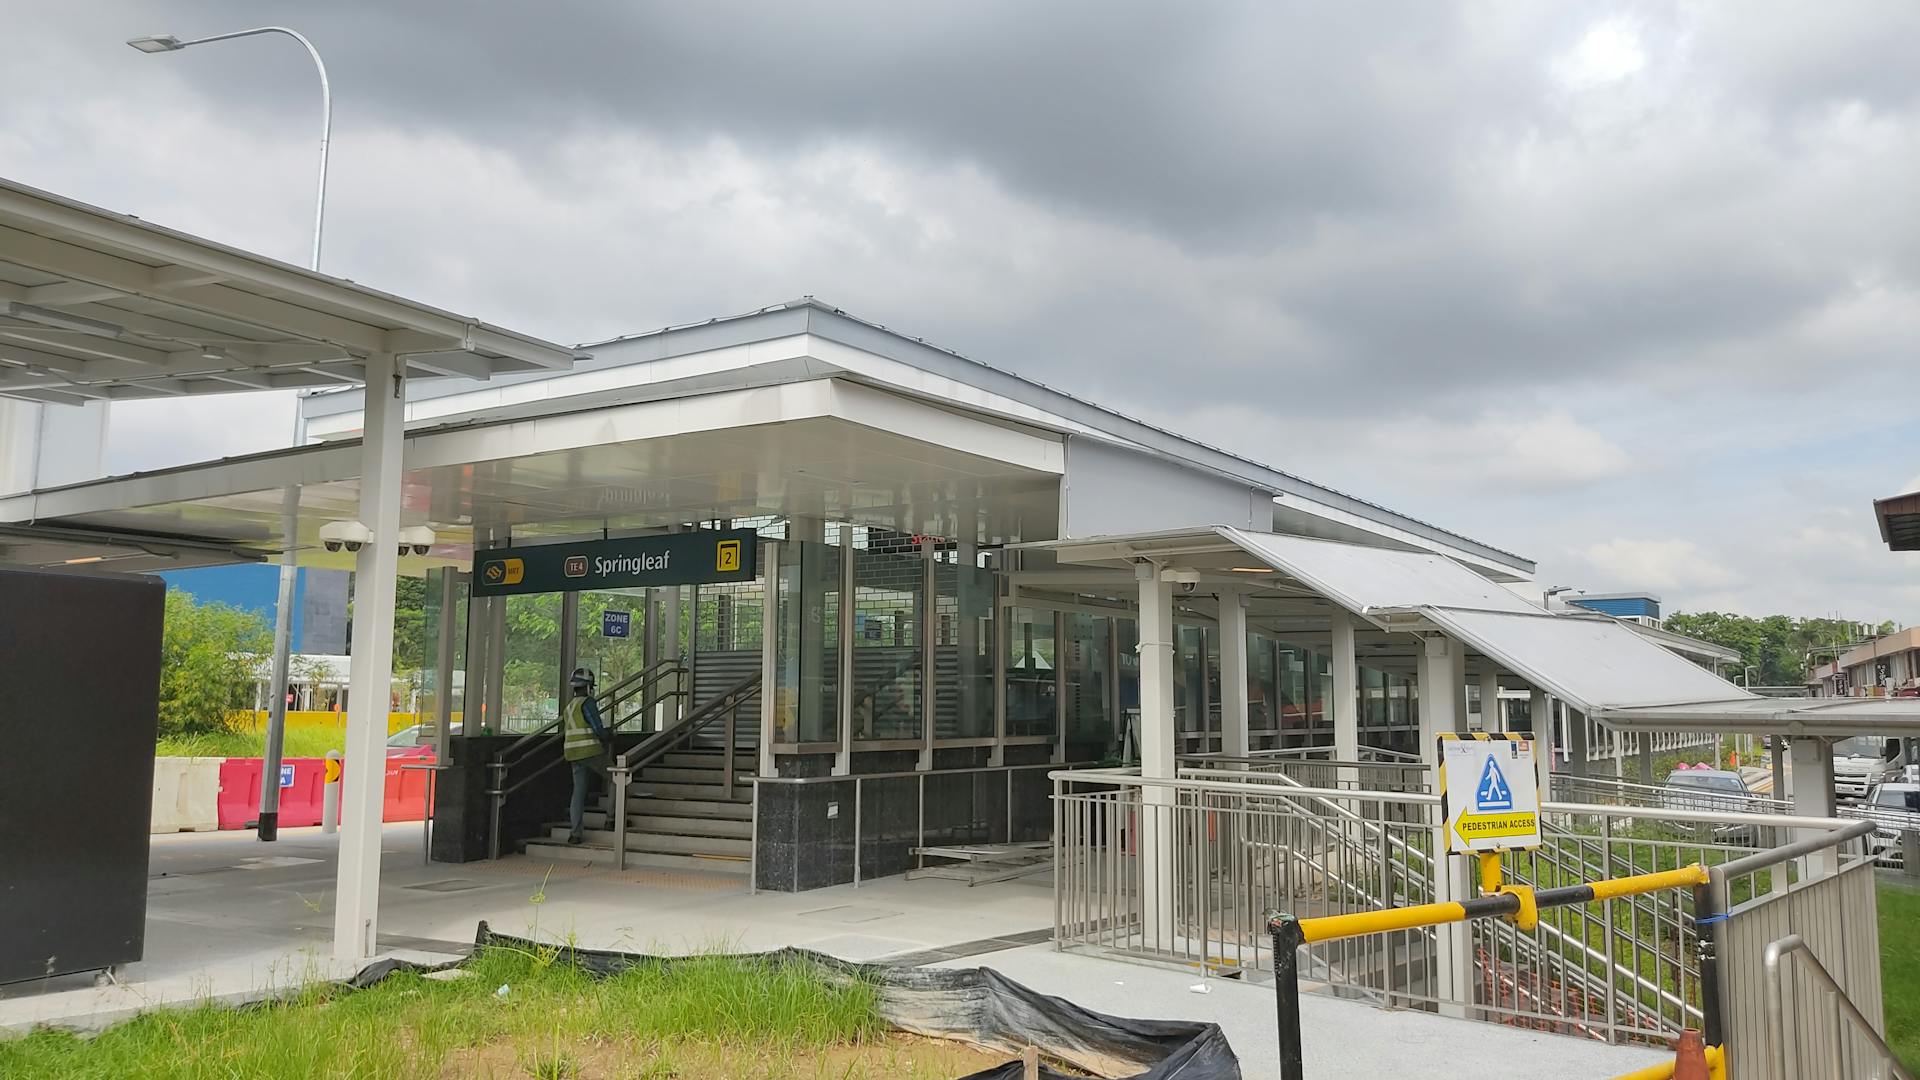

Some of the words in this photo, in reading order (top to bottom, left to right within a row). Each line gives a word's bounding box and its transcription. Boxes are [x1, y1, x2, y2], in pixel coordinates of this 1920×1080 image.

[725, 551, 732, 565] 2
[570, 562, 583, 572] TE4
[595, 551, 670, 578] Springleaf
[605, 613, 629, 624] ZONE
[610, 626, 622, 635] 6C
[1462, 821, 1508, 831] PEDESTRIAN
[1509, 819, 1535, 829] ACCESS
